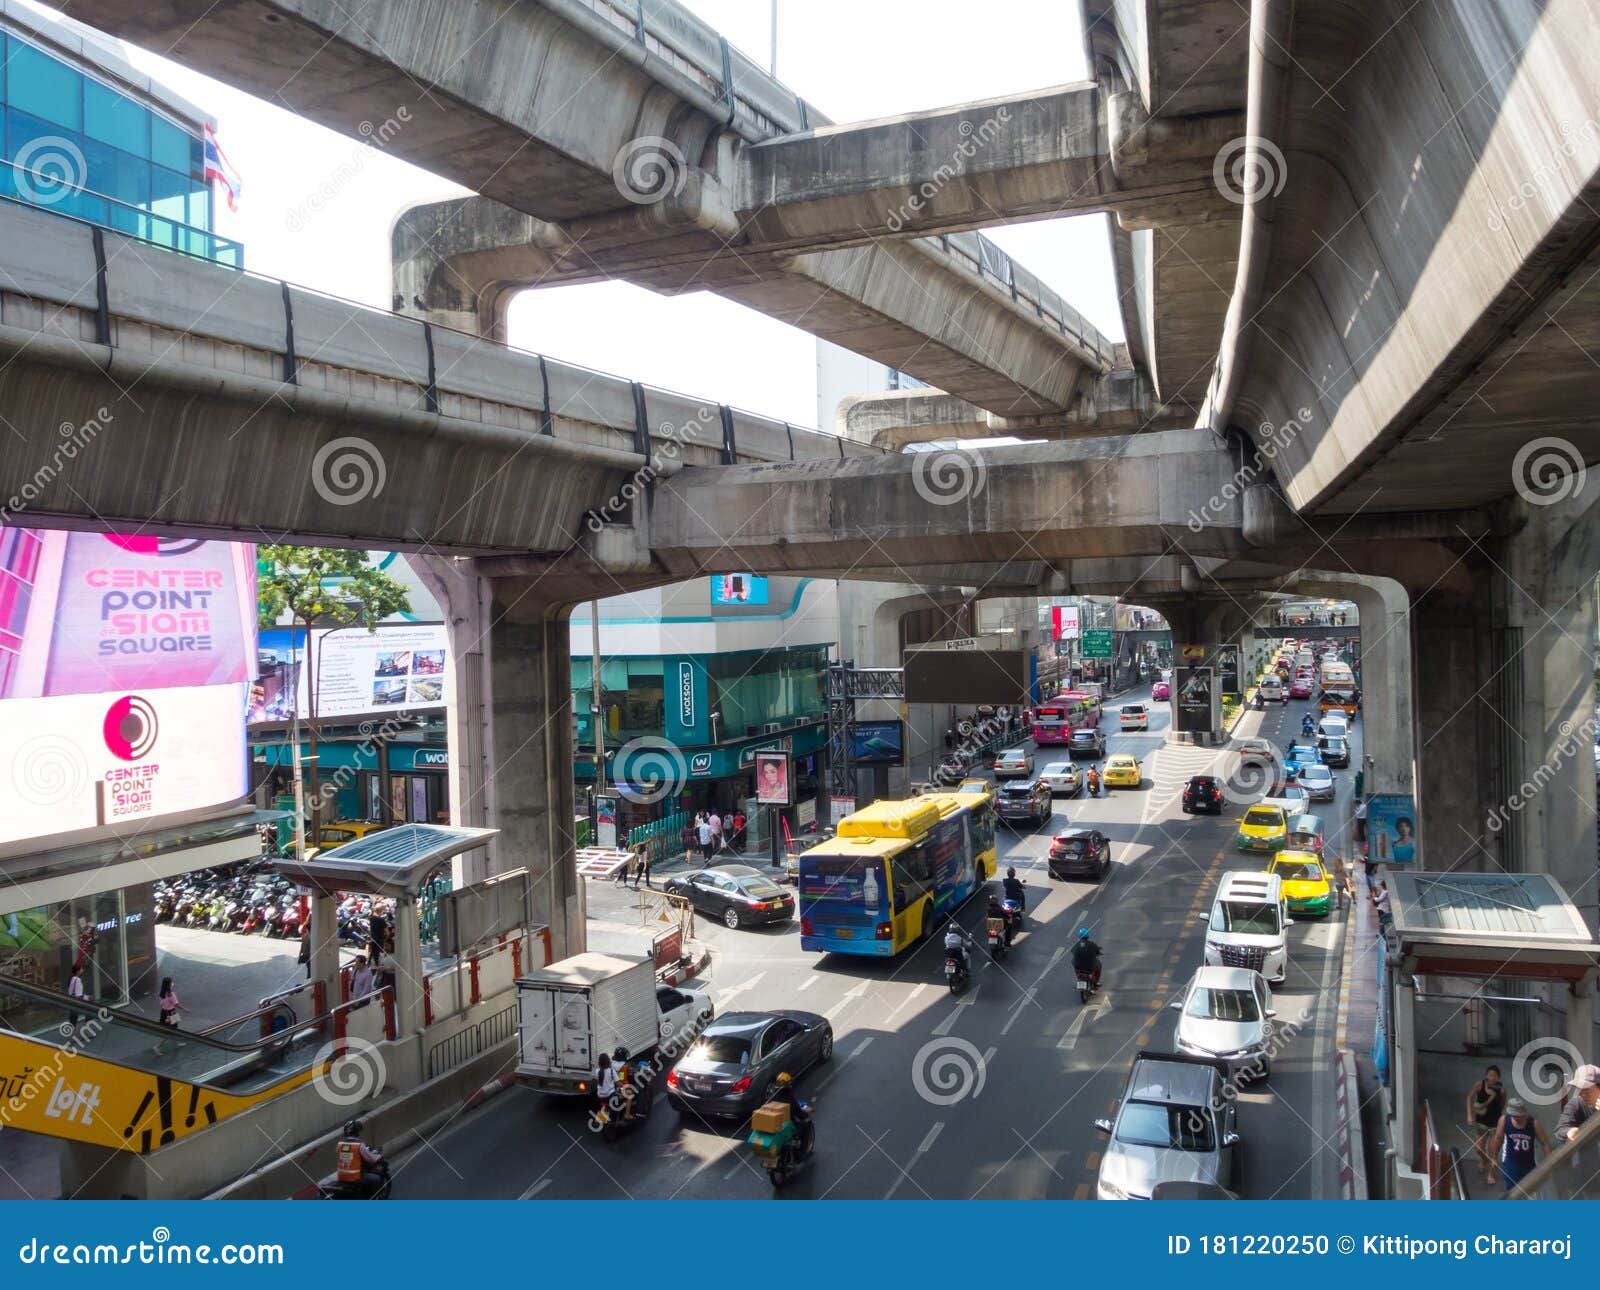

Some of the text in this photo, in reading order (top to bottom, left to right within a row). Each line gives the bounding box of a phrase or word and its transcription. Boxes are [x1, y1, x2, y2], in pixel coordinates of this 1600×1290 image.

[85, 569, 223, 588] CENTER
[98, 635, 212, 656] SQUARE
[683, 672, 691, 717] watsons
[105, 764, 159, 781] CENTER
